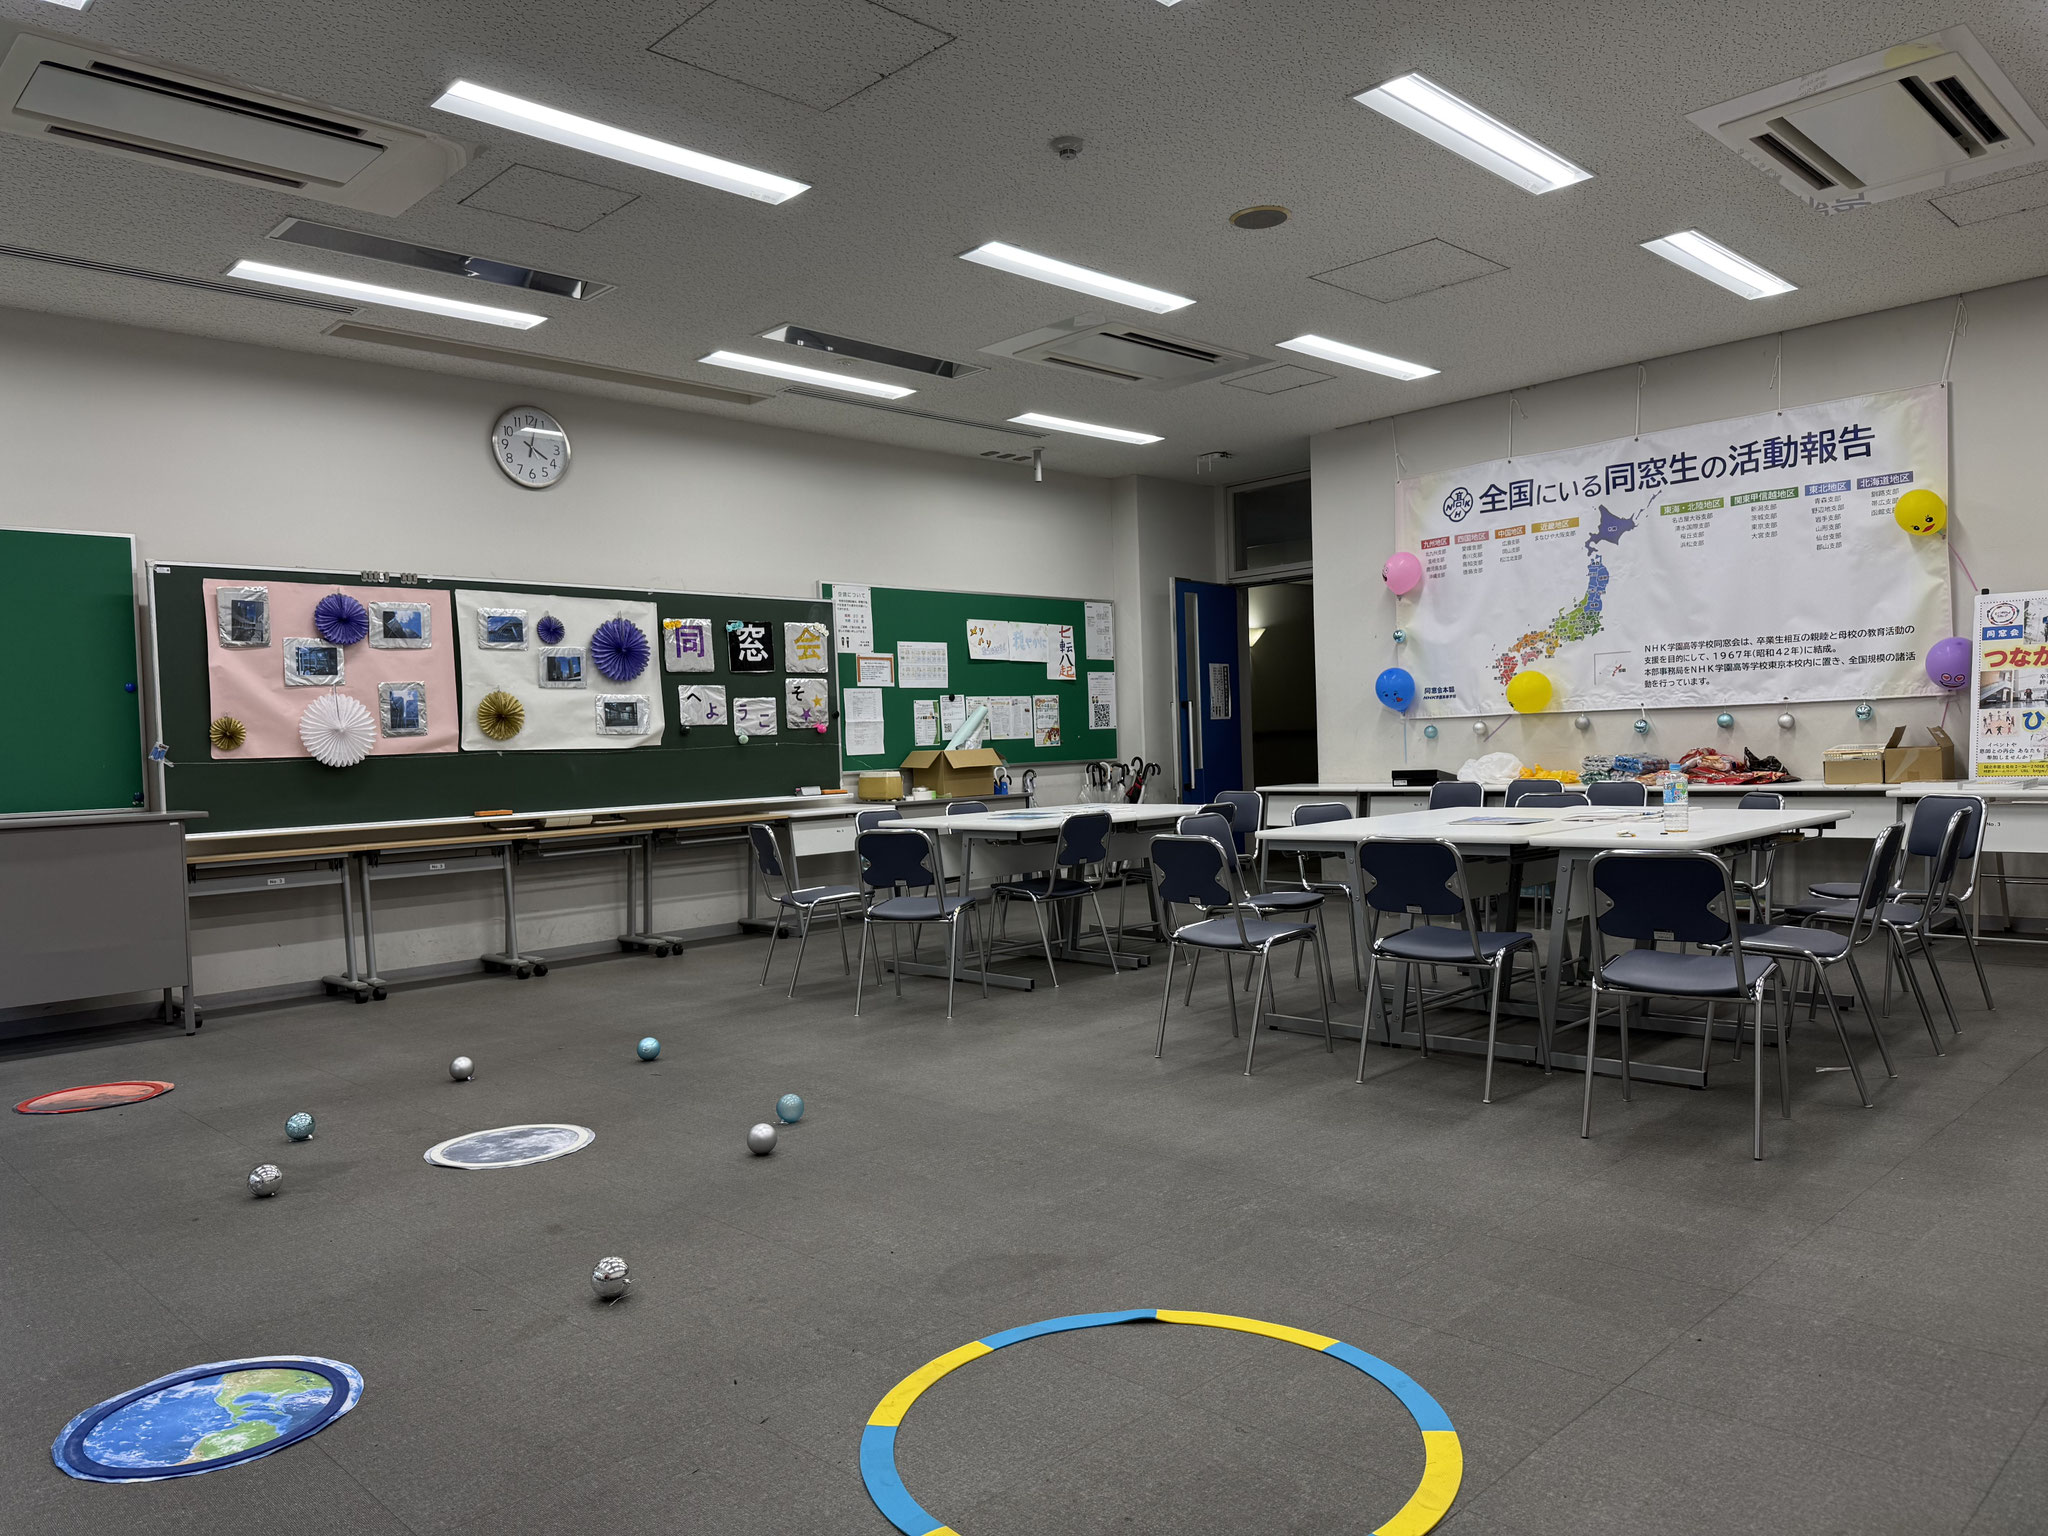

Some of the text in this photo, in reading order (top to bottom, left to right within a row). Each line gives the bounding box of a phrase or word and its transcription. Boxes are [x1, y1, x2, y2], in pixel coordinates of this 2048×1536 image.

[514, 417, 520, 427] 11
[525, 415, 534, 426] 12
[541, 420, 544, 428] 1
[504, 426, 513, 436] 10
[502, 439, 508, 449] 9
[554, 445, 560, 455] 3
[506, 453, 513, 463] 8
[517, 464, 523, 474] 7
[550, 459, 557, 469] 4
[1479, 424, 1875, 514] 全国にいる同窓生の活動報告
[529, 469, 536, 479] 6
[542, 467, 548, 477] 5
[1860, 473, 1910, 488] 北海道地区
[1808, 482, 1846, 495] 東北地区
[1734, 489, 1795, 505] 関東甲信越地区
[1663, 500, 1720, 514] 東海・北陸地区
[1059, 626, 1075, 678] 七転八起
